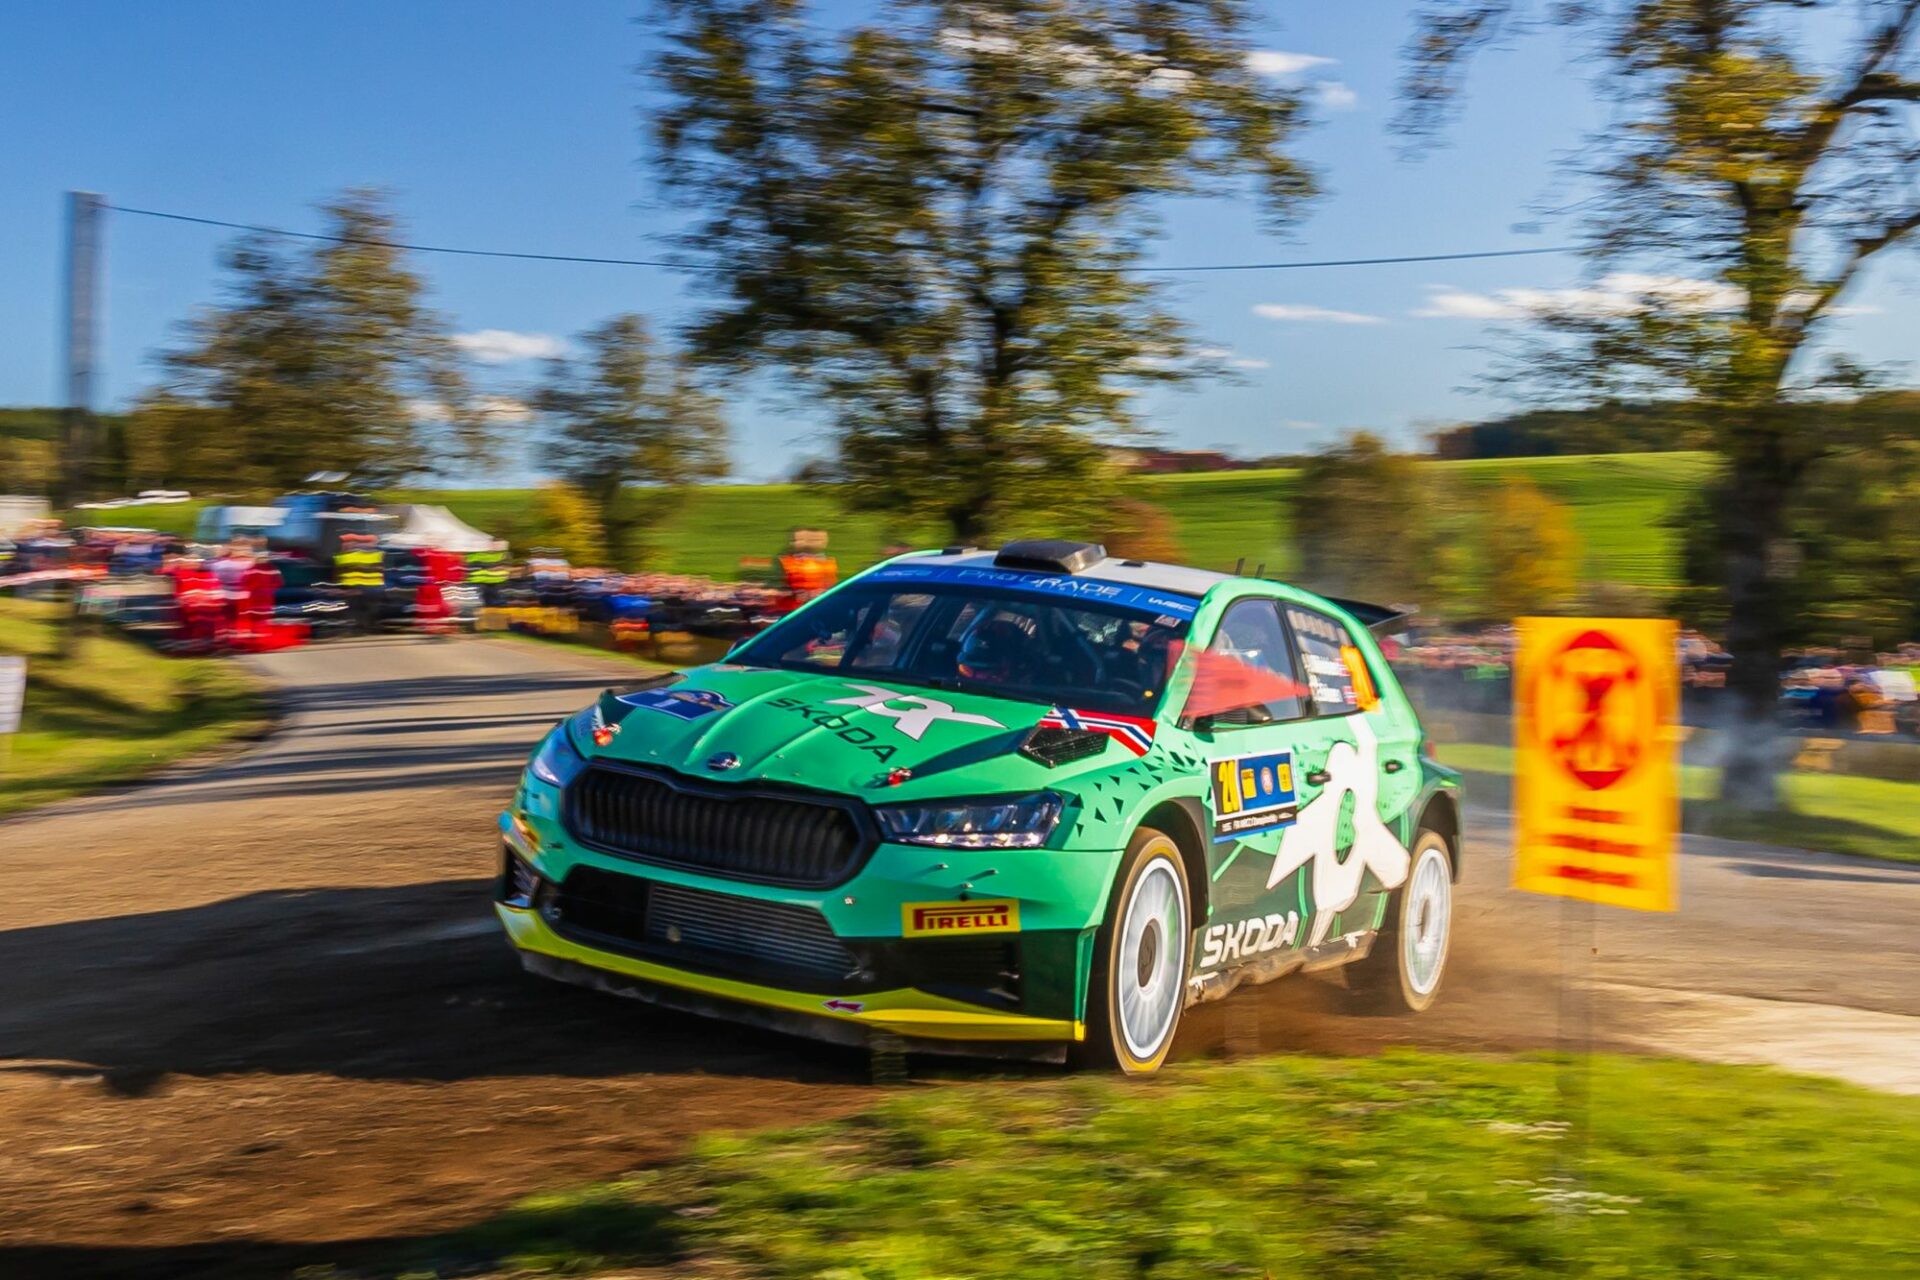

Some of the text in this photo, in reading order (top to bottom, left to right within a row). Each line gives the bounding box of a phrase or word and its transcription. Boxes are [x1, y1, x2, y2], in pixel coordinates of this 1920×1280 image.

[766, 697, 899, 763] SKODA
[912, 905, 1009, 930] PIRELLI
[1200, 910, 1300, 967] SKODA
